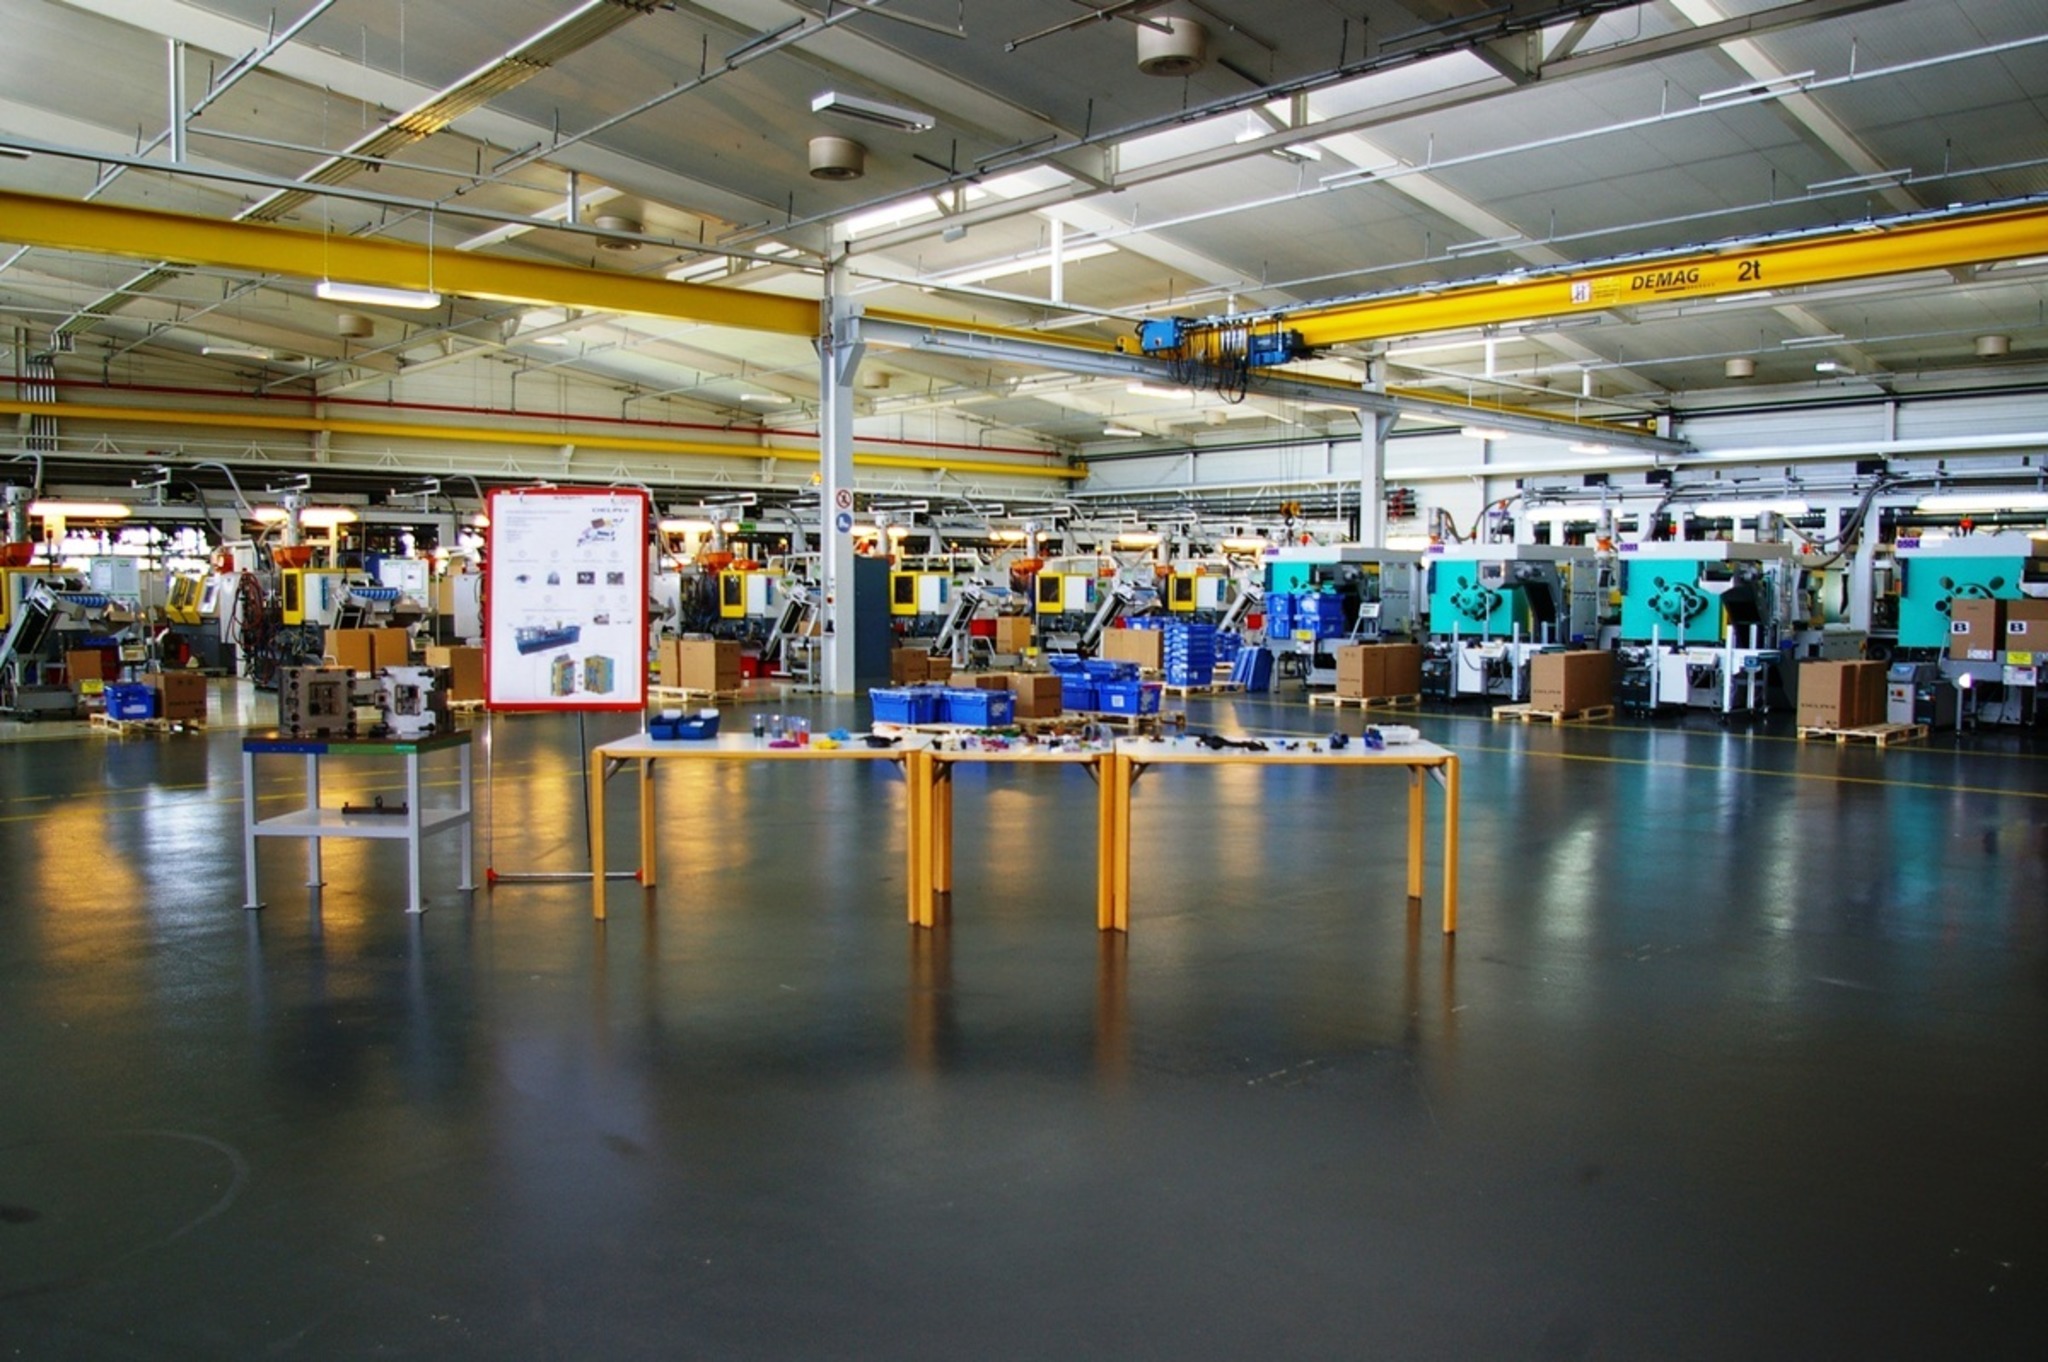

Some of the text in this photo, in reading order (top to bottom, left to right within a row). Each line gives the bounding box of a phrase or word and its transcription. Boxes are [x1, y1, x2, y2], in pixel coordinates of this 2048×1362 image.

[1737, 260, 1761, 282] 2t
[1631, 268, 1699, 291] DEMAG
[1953, 622, 1967, 632] B
[2010, 622, 2024, 632] B
